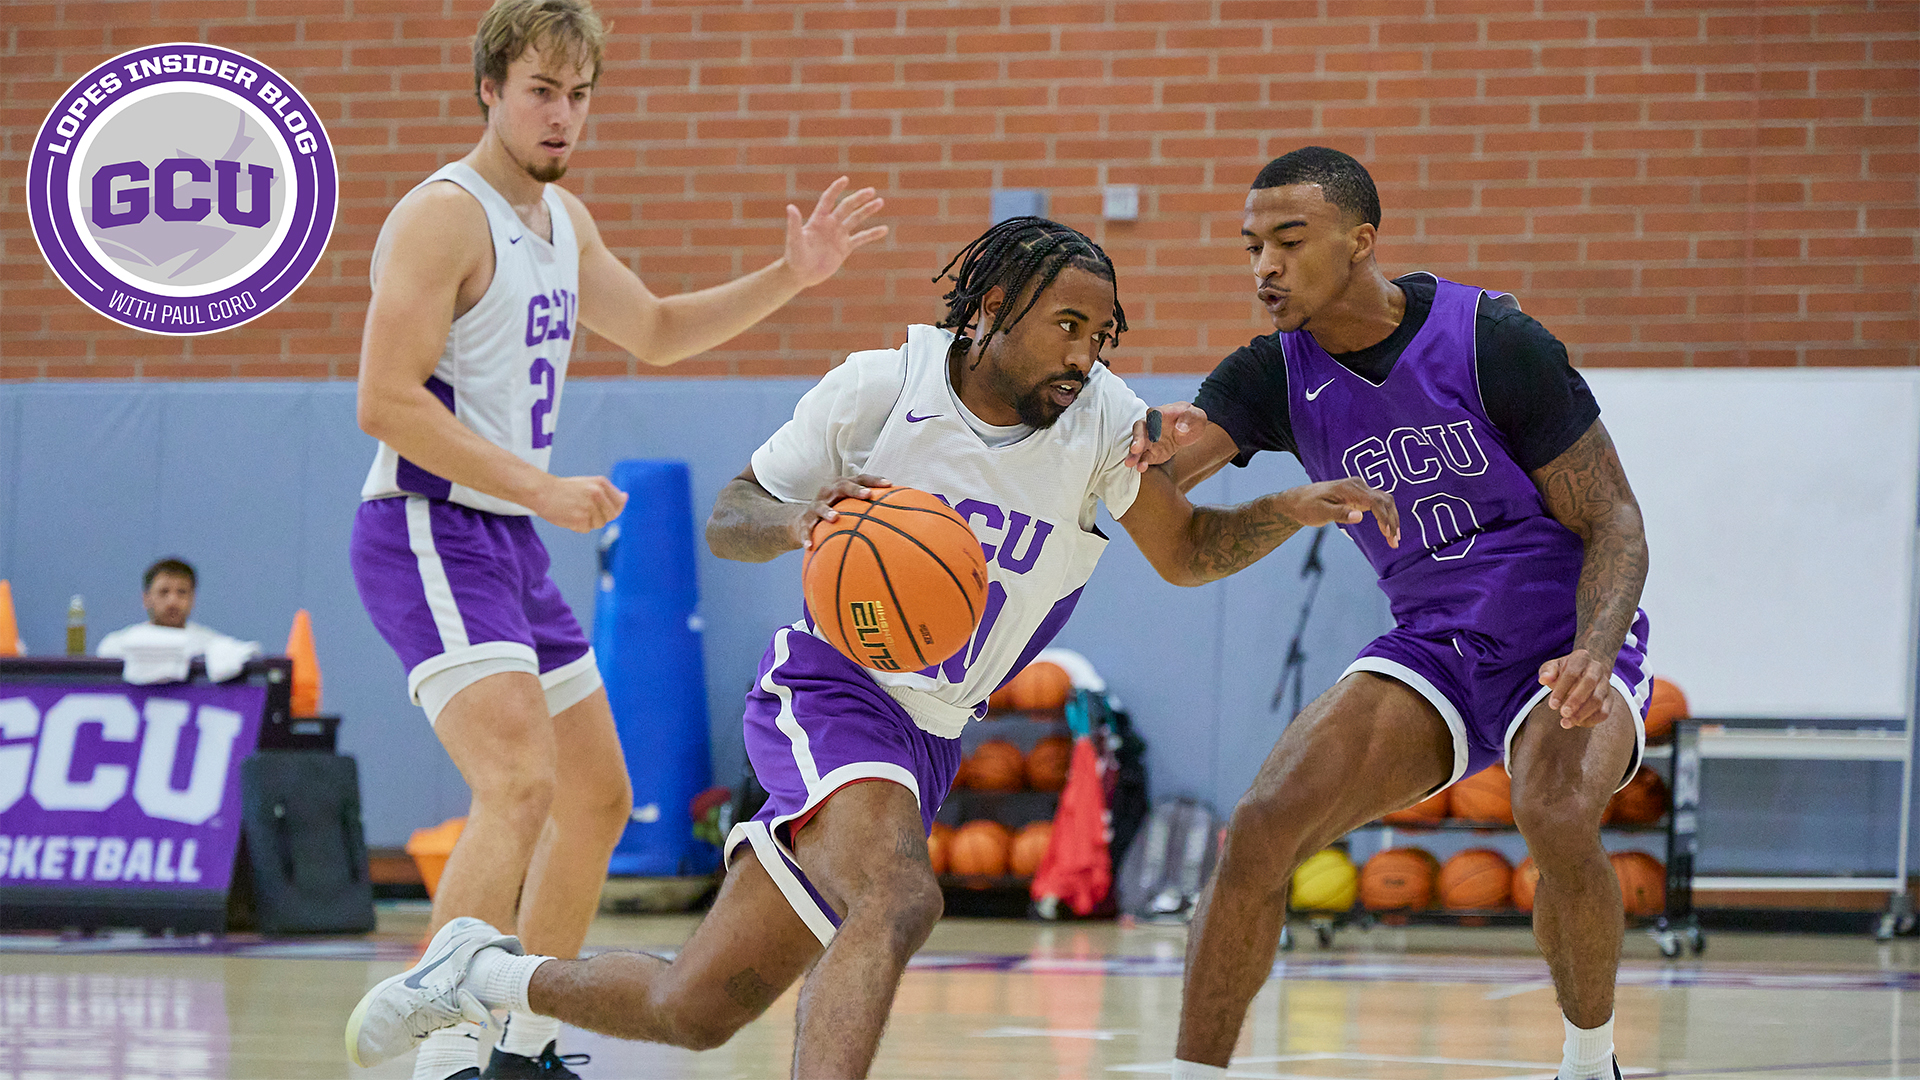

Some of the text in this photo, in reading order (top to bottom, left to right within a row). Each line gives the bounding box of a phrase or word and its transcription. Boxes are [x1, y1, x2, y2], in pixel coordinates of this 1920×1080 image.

[1342, 420, 1489, 494] GCU
[932, 494, 1054, 575] CU
[1411, 492, 1485, 561] 0
[849, 601, 901, 671] ELITE
